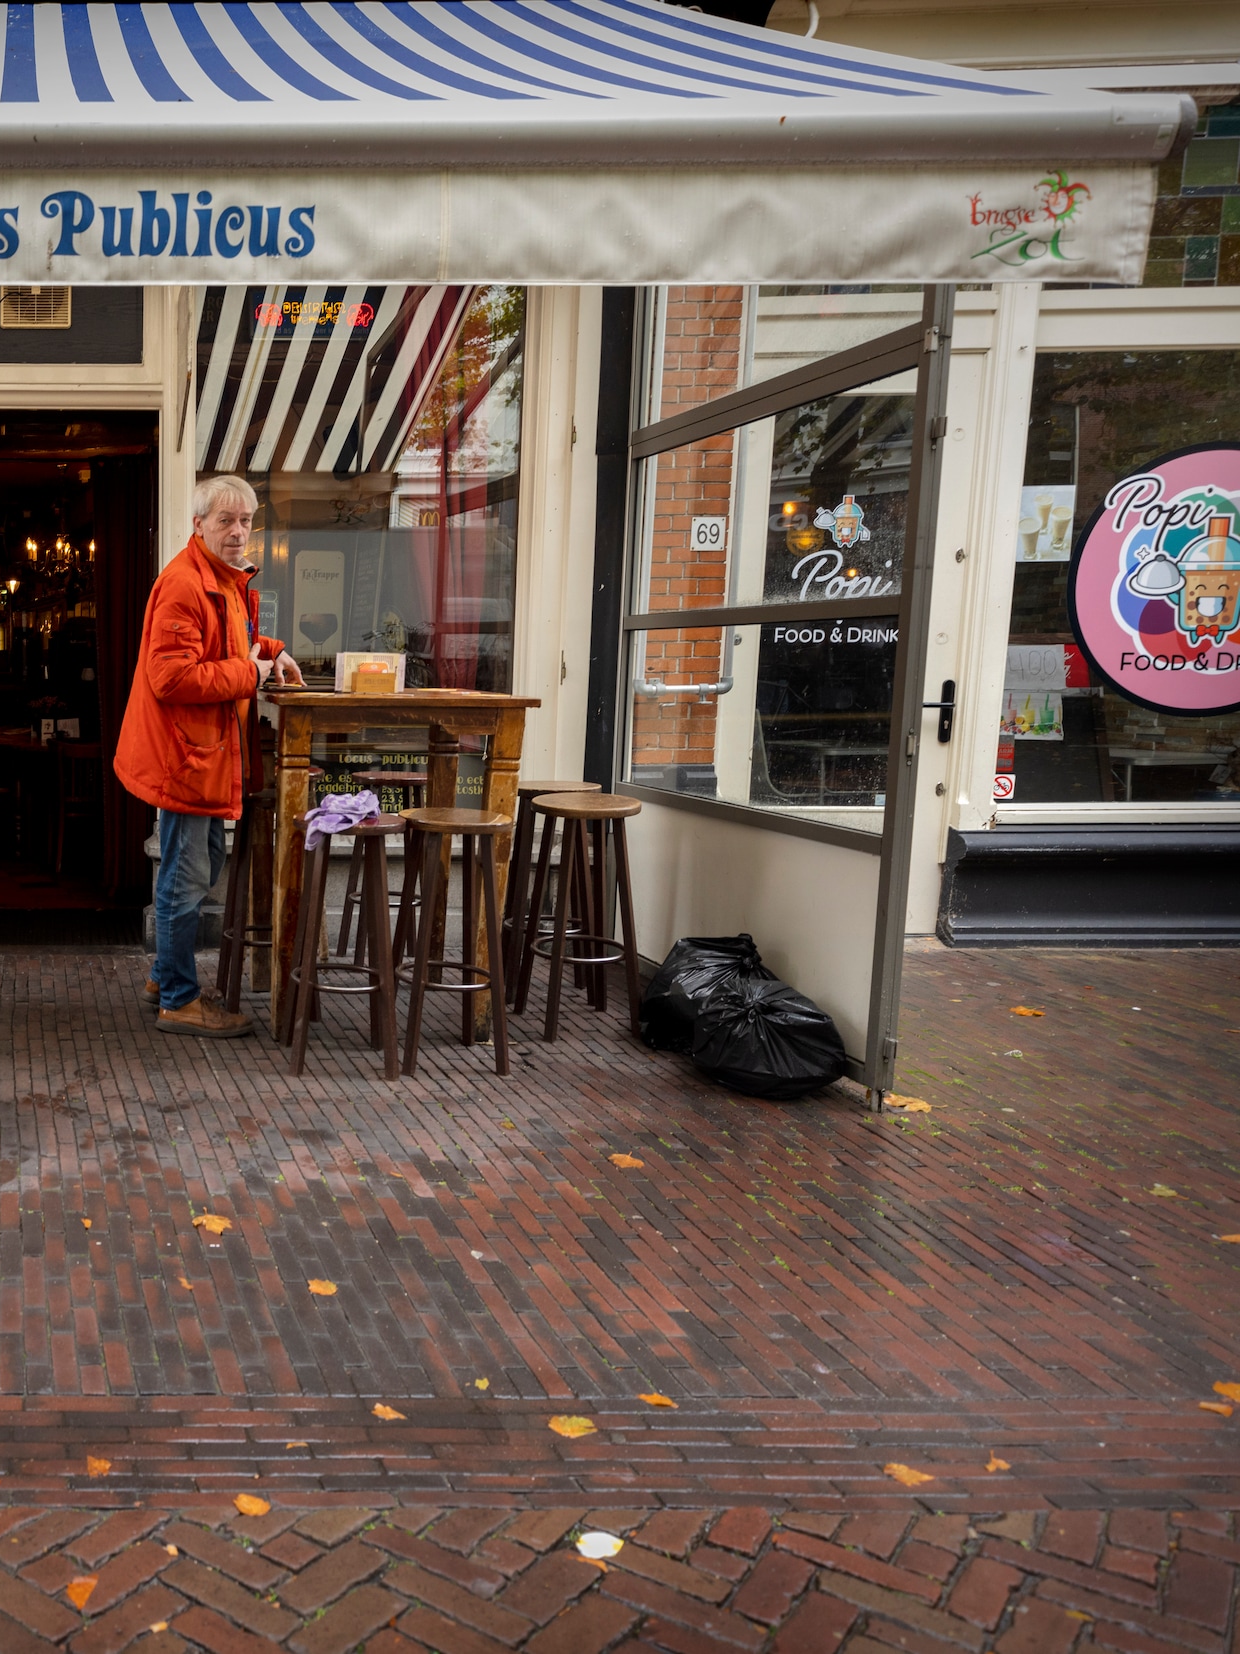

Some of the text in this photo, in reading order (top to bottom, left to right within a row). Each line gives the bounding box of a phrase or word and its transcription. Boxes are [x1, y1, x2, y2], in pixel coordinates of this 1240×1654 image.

[40, 189, 316, 260] Publicus
[966, 192, 1038, 235] brugse
[970, 229, 1085, 267] Zot
[1105, 476, 1215, 552] Popi
[697, 523, 720, 545] 69
[792, 550, 893, 606] Popi
[774, 626, 899, 644] FOOD & DRINK
[1120, 652, 1187, 672] FOOD
[1193, 651, 1210, 672] &
[382, 753, 429, 765] publicu
